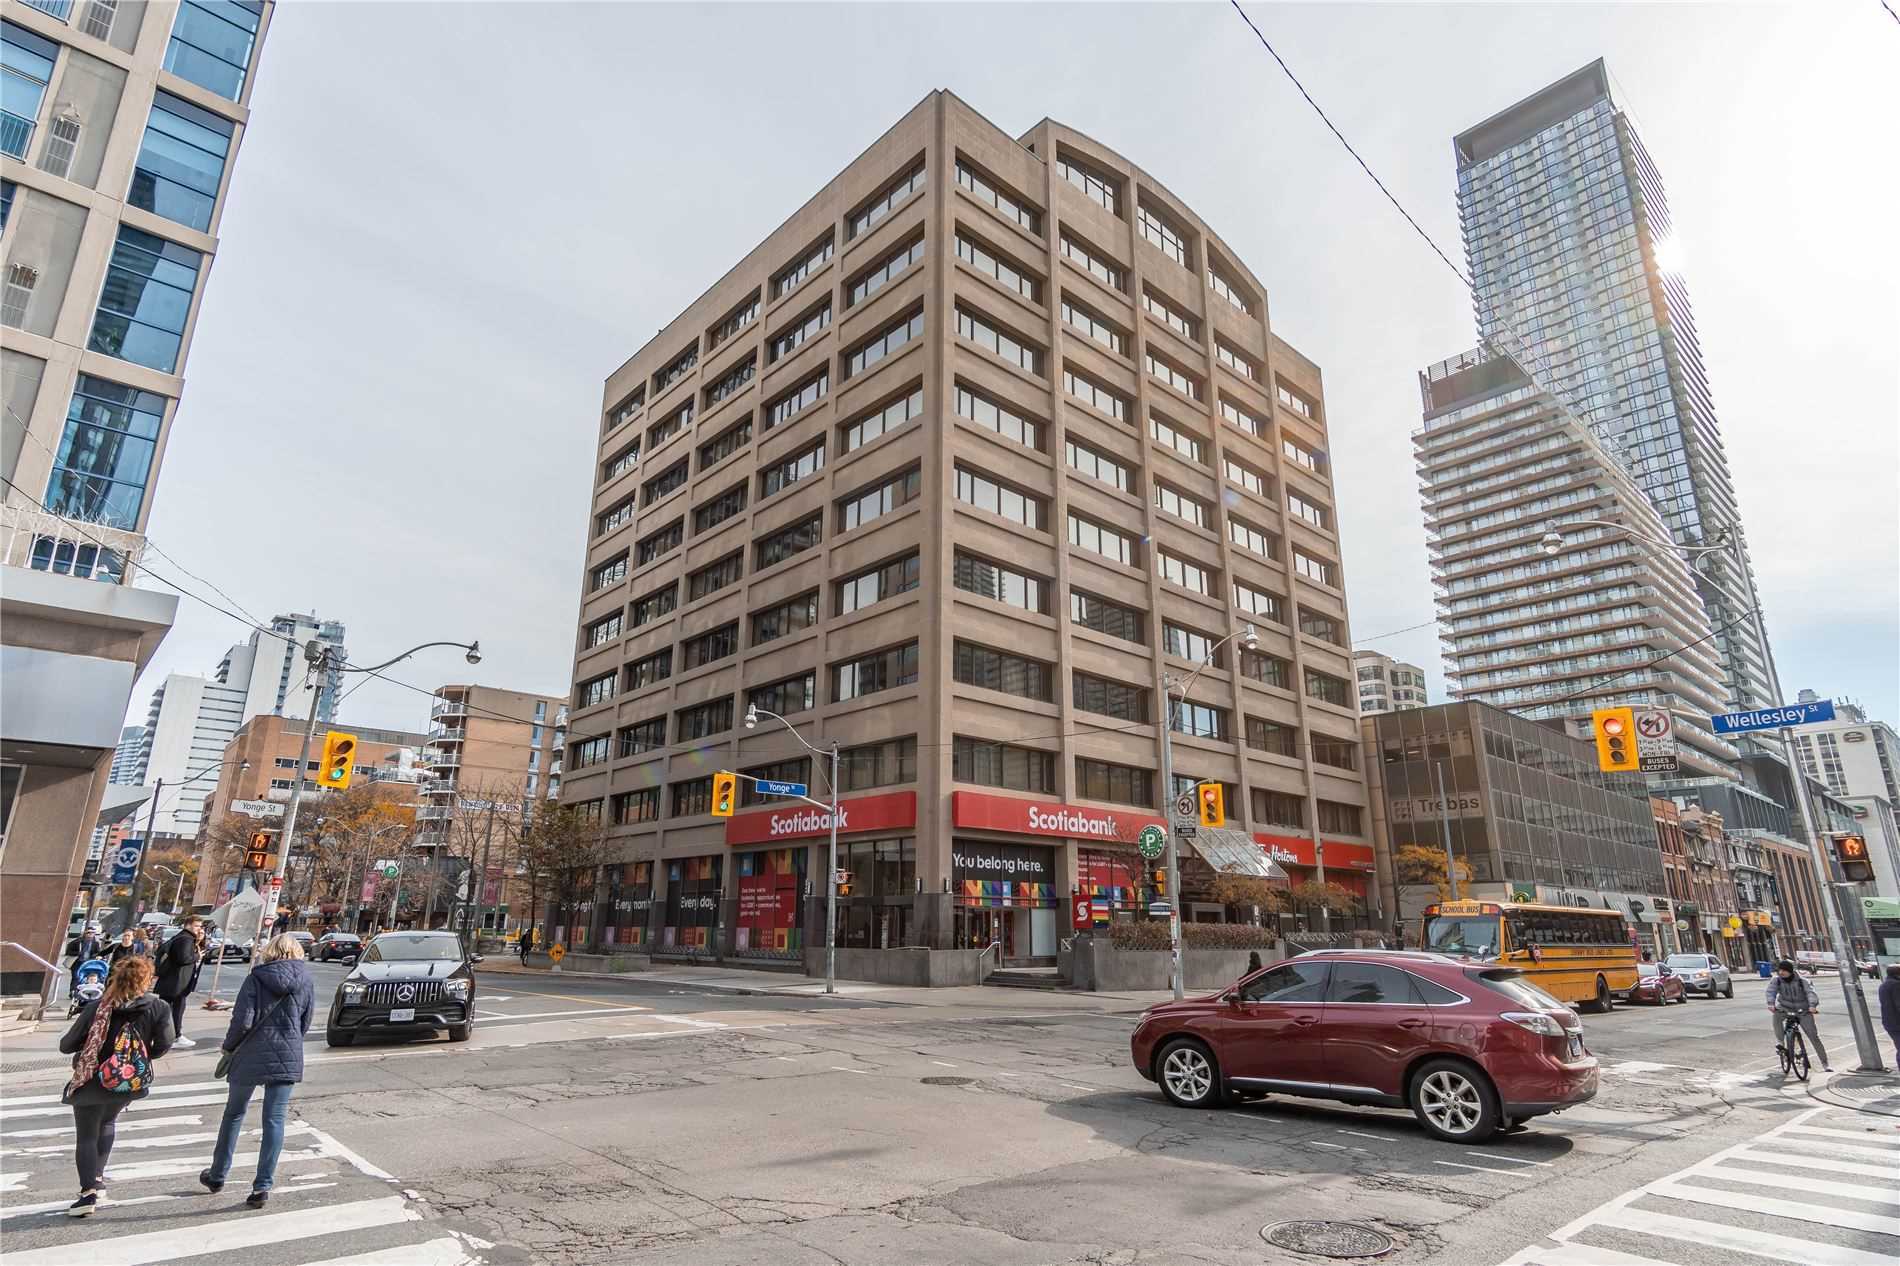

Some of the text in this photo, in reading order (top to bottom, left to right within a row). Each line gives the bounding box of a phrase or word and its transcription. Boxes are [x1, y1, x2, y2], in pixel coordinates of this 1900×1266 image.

[1725, 704, 1819, 728] Wellesley St
[768, 782, 790, 793] Yonge
[241, 802, 276, 812] Yonge St
[1418, 798, 1480, 813] Trebas
[1028, 806, 1119, 836] Scotiabank
[1146, 834, 1156, 847] P
[952, 853, 1044, 873] You belong here.
[680, 896, 699, 910] Every
[1467, 905, 1480, 913] BUS
